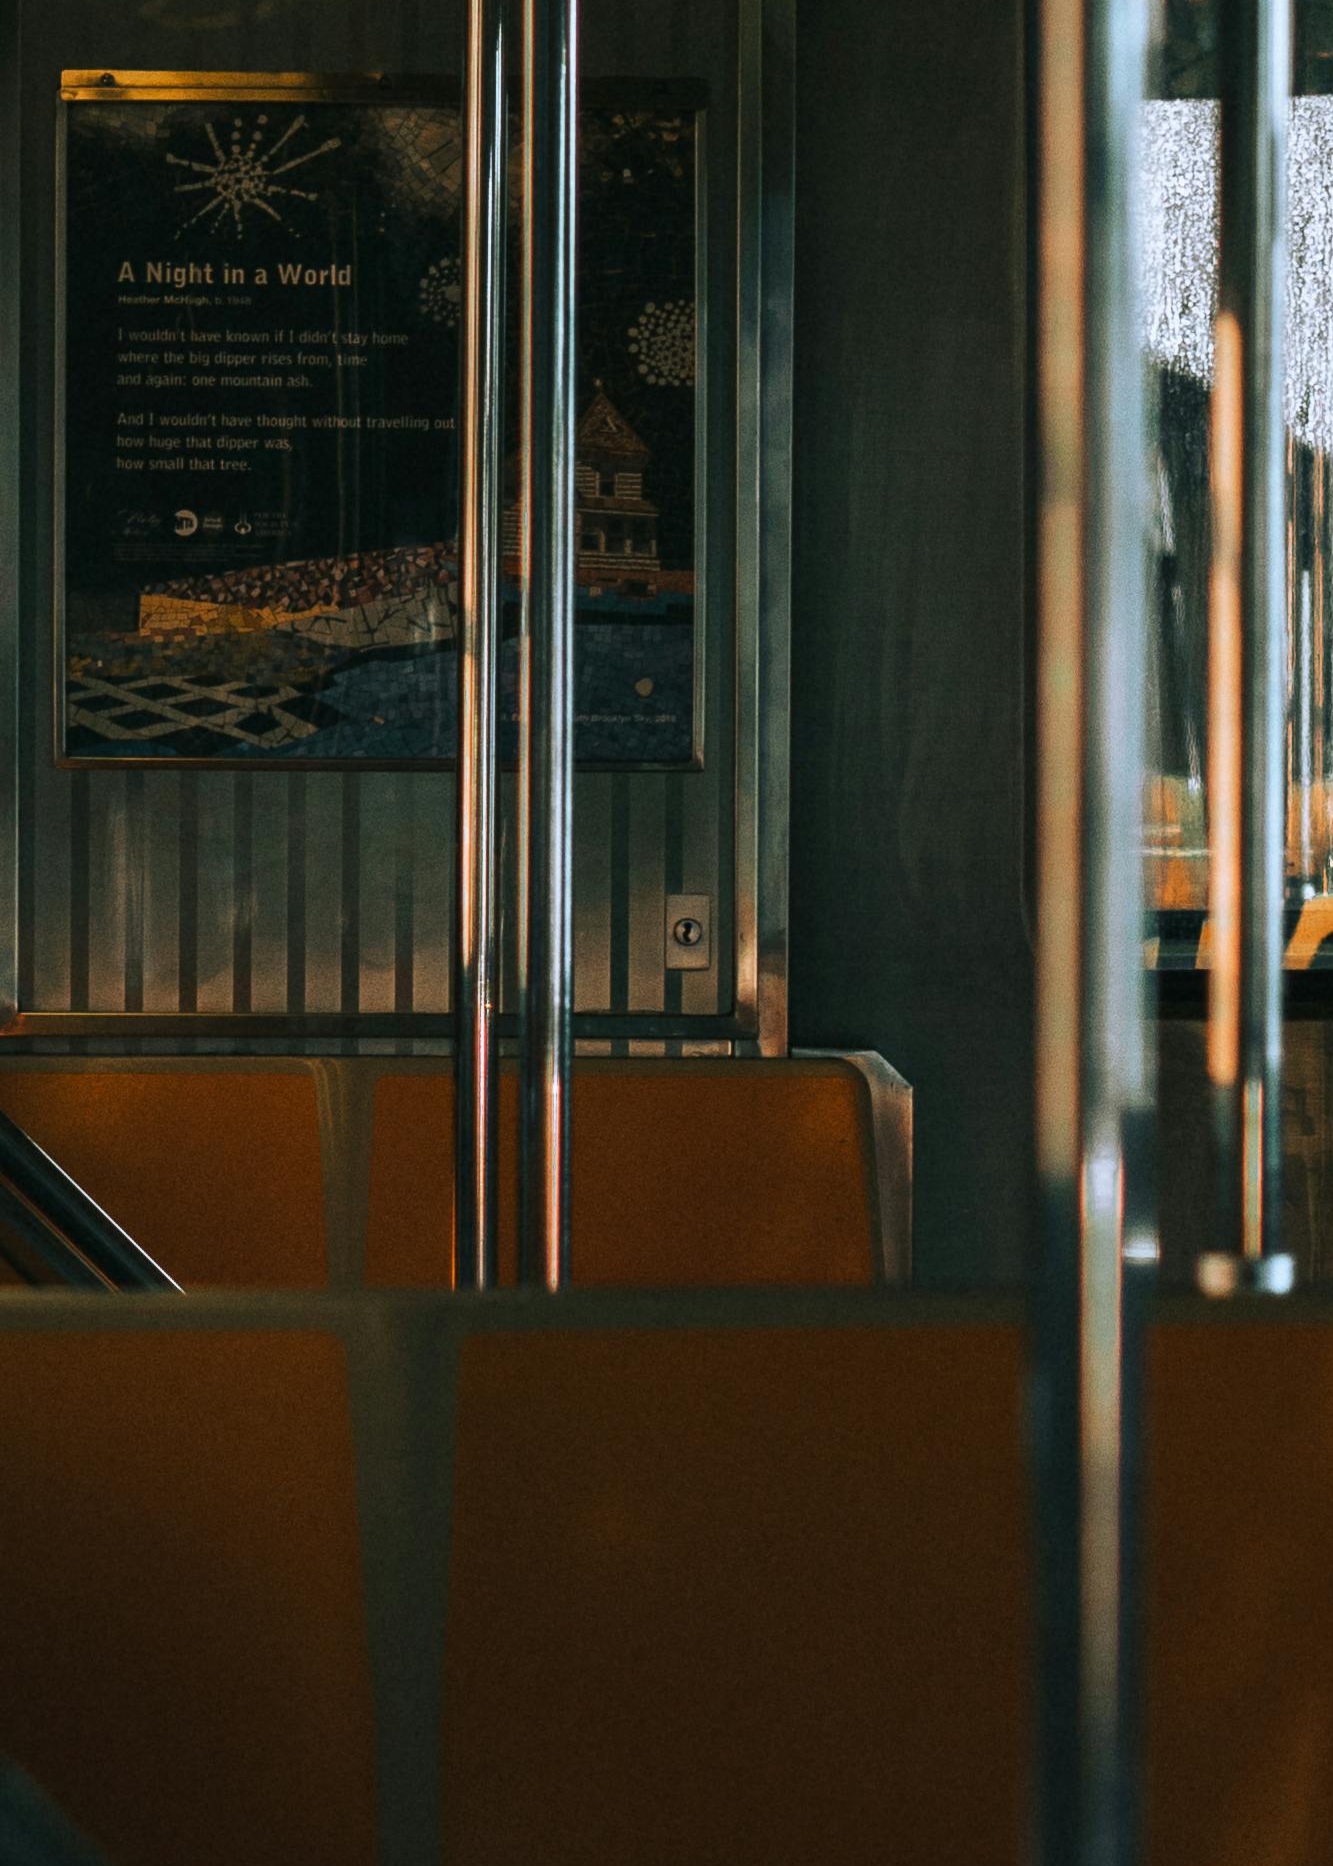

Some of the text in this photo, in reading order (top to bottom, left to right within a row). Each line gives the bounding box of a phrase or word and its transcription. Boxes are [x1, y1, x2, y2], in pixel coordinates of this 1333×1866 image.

[118, 261, 352, 288] A Night in a World
[118, 296, 160, 305] Heather
[117, 329, 122, 341] I
[128, 329, 185, 342] wouldn't
[190, 330, 221, 342] have
[226, 330, 270, 343] known
[274, 330, 284, 343] if
[299, 331, 339, 344] didn't
[342, 332, 367, 346] stay
[372, 332, 409, 345] home
[117, 351, 368, 368] where the big dipper rises from, time
[117, 373, 313, 388] and again: one mountain ash.
[117, 413, 144, 425] And
[159, 413, 217, 426] wouldn't
[221, 414, 252, 427] have
[256, 415, 307, 430] thought
[312, 416, 361, 429] without
[366, 417, 429, 431] travelling
[433, 418, 455, 429] out
[116, 436, 293, 452] how huge that dipper was,
[116, 458, 252, 472] how small that tree.
